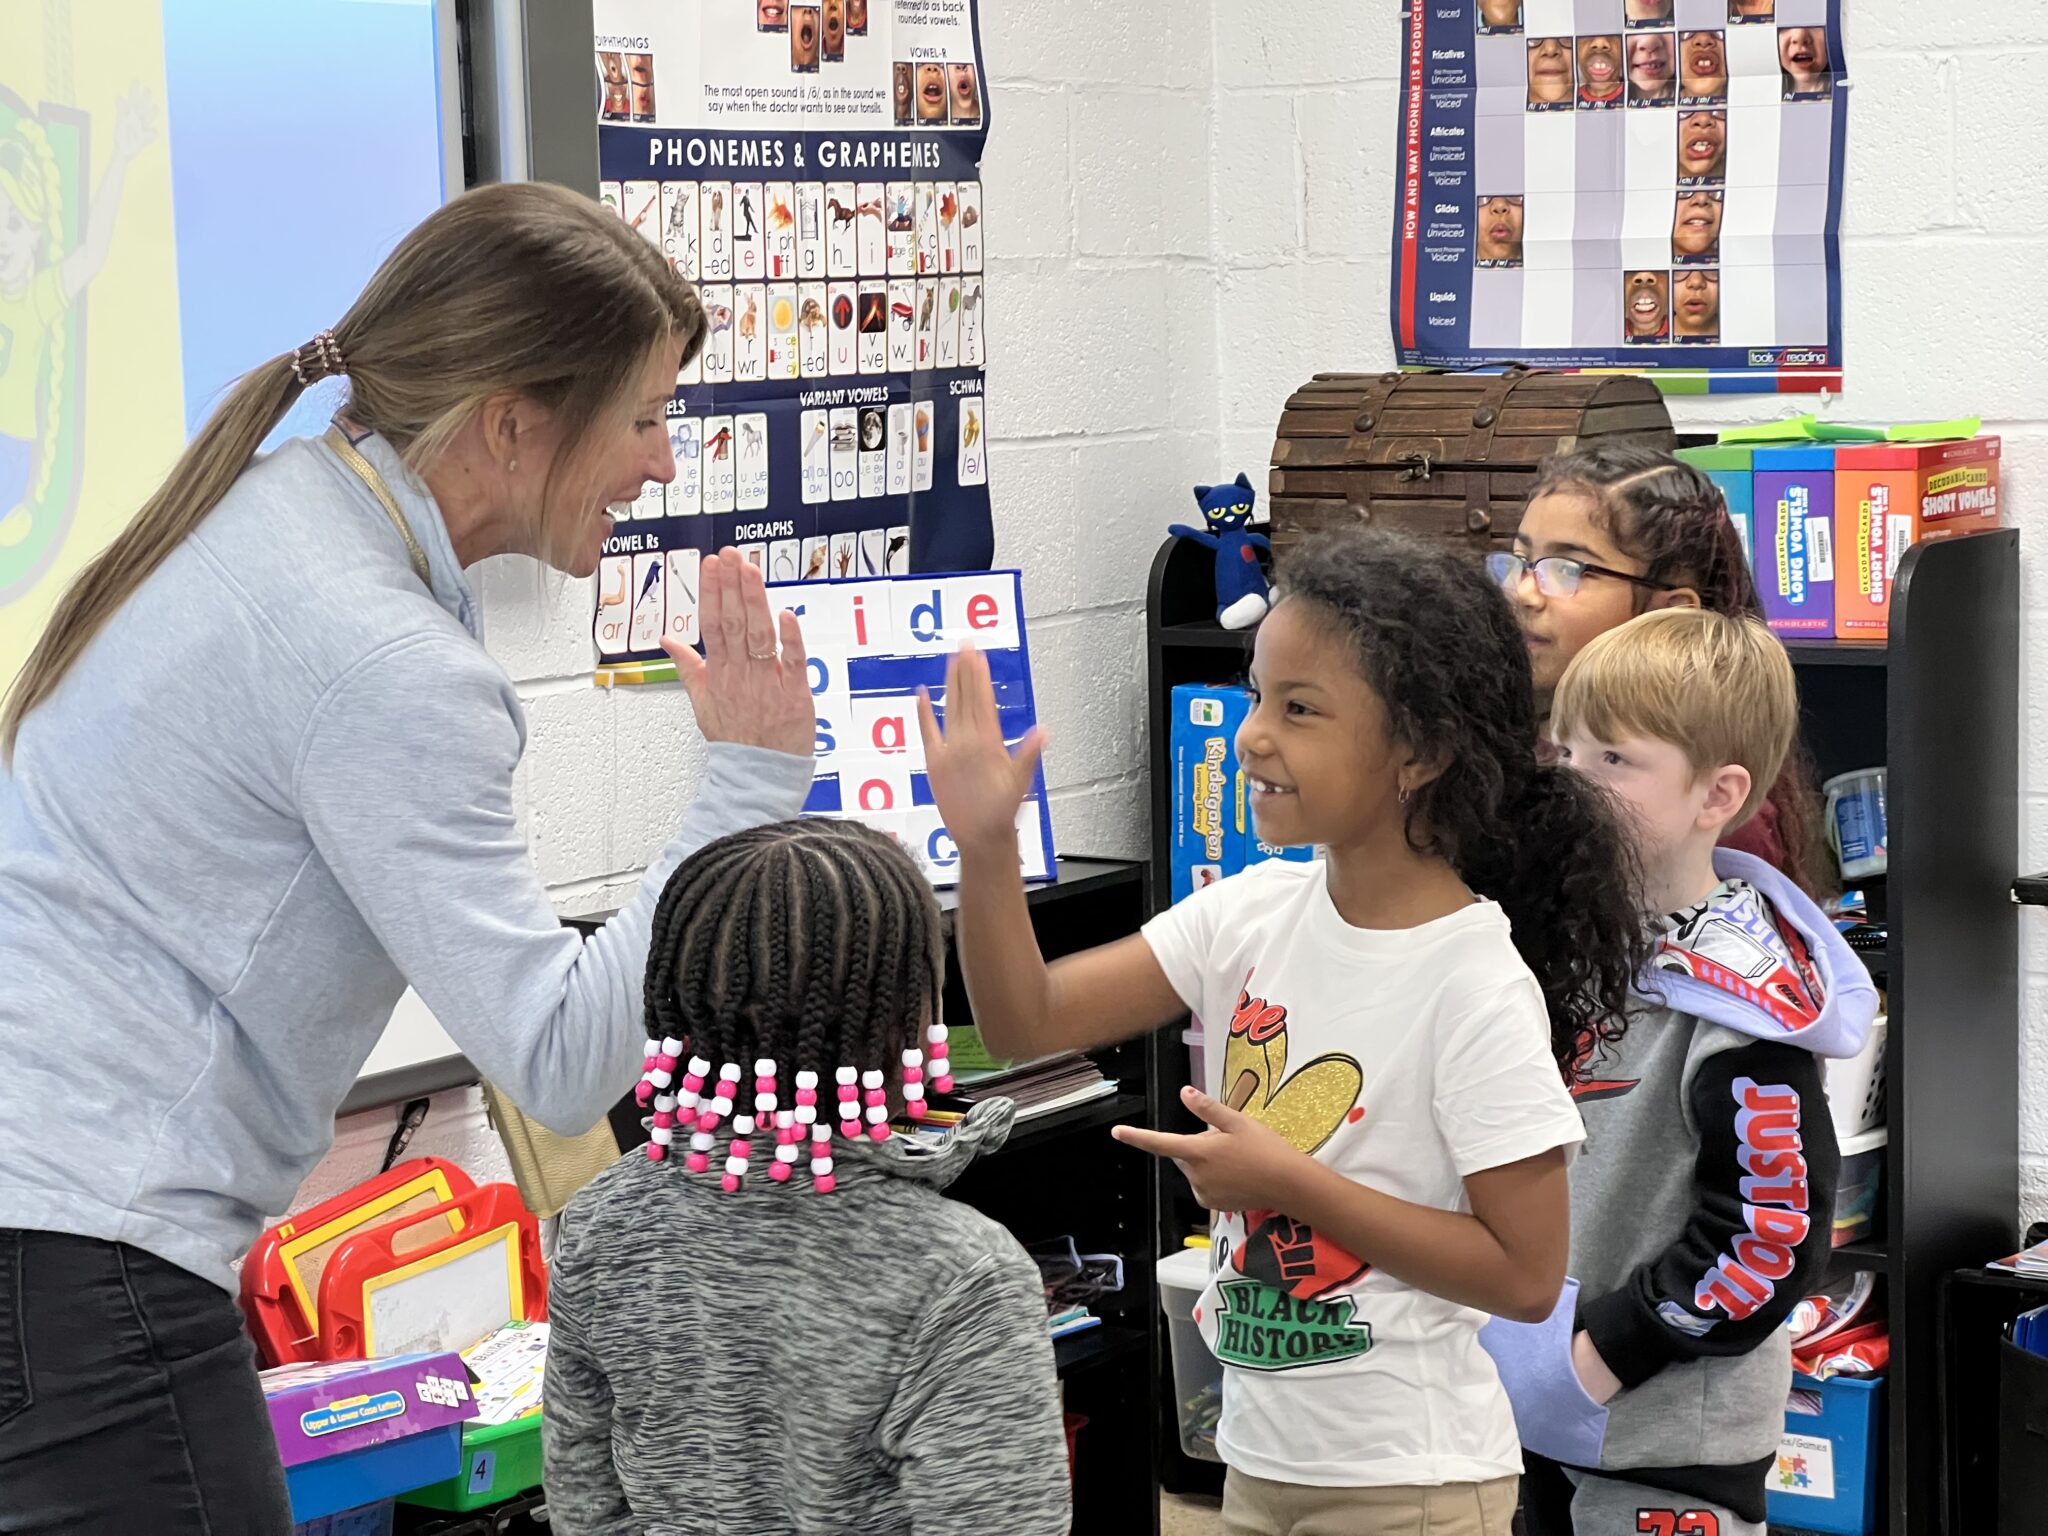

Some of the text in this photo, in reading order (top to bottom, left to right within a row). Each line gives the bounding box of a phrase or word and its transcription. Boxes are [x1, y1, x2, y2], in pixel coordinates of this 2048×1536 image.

[931, 2, 940, 11] as
[943, 2, 965, 12] back
[1436, 8, 1460, 18] Voiced
[898, 14, 960, 26] rounded vowels.
[910, 47, 947, 58] VOWEL-R
[1432, 49, 1465, 60] Fricatives
[1412, 69, 1420, 80] IS
[1431, 74, 1466, 84] Unvoiced
[704, 85, 719, 97] The
[722, 85, 743, 97] most
[744, 88, 769, 100] open
[771, 86, 798, 98] sound
[799, 87, 805, 98] is
[823, 89, 831, 99] as
[832, 87, 839, 98] in
[840, 87, 852, 98] the
[853, 87, 874, 99] sound
[875, 89, 886, 99] we
[708, 101, 723, 113] say
[726, 101, 750, 113] when
[752, 101, 767, 112] the
[769, 101, 798, 112] doctor
[800, 103, 823, 113] wants
[825, 103, 832, 113] to
[833, 105, 846, 113] see
[848, 104, 859, 113] our
[1436, 99, 1462, 108] Voiced
[1409, 85, 1421, 144] PHONEME
[1430, 127, 1465, 137] Affricates
[650, 138, 941, 168] PHONEMES & GRAPHEMES
[1409, 150, 1418, 174] WAY
[1429, 151, 1465, 161] Unvoiced
[1434, 177, 1461, 186] Voiced
[1408, 179, 1418, 205] AND
[1435, 204, 1459, 214] Glides
[1405, 210, 1416, 239] HOW
[1427, 228, 1465, 238] Unvoiced
[744, 250, 755, 267] e
[804, 249, 815, 272] g
[1431, 252, 1459, 262] Voiced
[1429, 292, 1457, 303] Liquids
[1428, 317, 1456, 326] Voiced
[800, 386, 888, 407] VARIANT VOWELS
[950, 378, 983, 396] SCHWA
[666, 399, 686, 415] ELS
[1929, 471, 1966, 491] DECODABLE
[1922, 486, 1996, 518] SHORT VOWELS
[735, 520, 794, 540] DIGRAPHS
[601, 534, 659, 554] VOWEL Rs
[1789, 486, 1804, 603] LONG VOWELS
[1870, 486, 1883, 603] SHORT VOWELS
[1778, 535, 1788, 593] DECODABLE
[1860, 535, 1868, 592] DECODABLE
[602, 621, 623, 640] ar
[672, 614, 692, 632] or
[1774, 620, 1827, 628] SCHOLASTIC
[1195, 767, 1203, 801] Learning
[1203, 740, 1225, 857] Kindergarten
[1733, 1077, 1808, 1211] JUST
[1733, 1203, 1810, 1280] DO
[1231, 1284, 1342, 1326] BLACK
[1224, 1318, 1360, 1360] HISTORY
[306, 1417, 329, 1431] Upper
[337, 1410, 359, 1422] Lower
[359, 1406, 378, 1417] Case
[378, 1400, 401, 1412] Letters
[474, 1458, 487, 1480] 4
